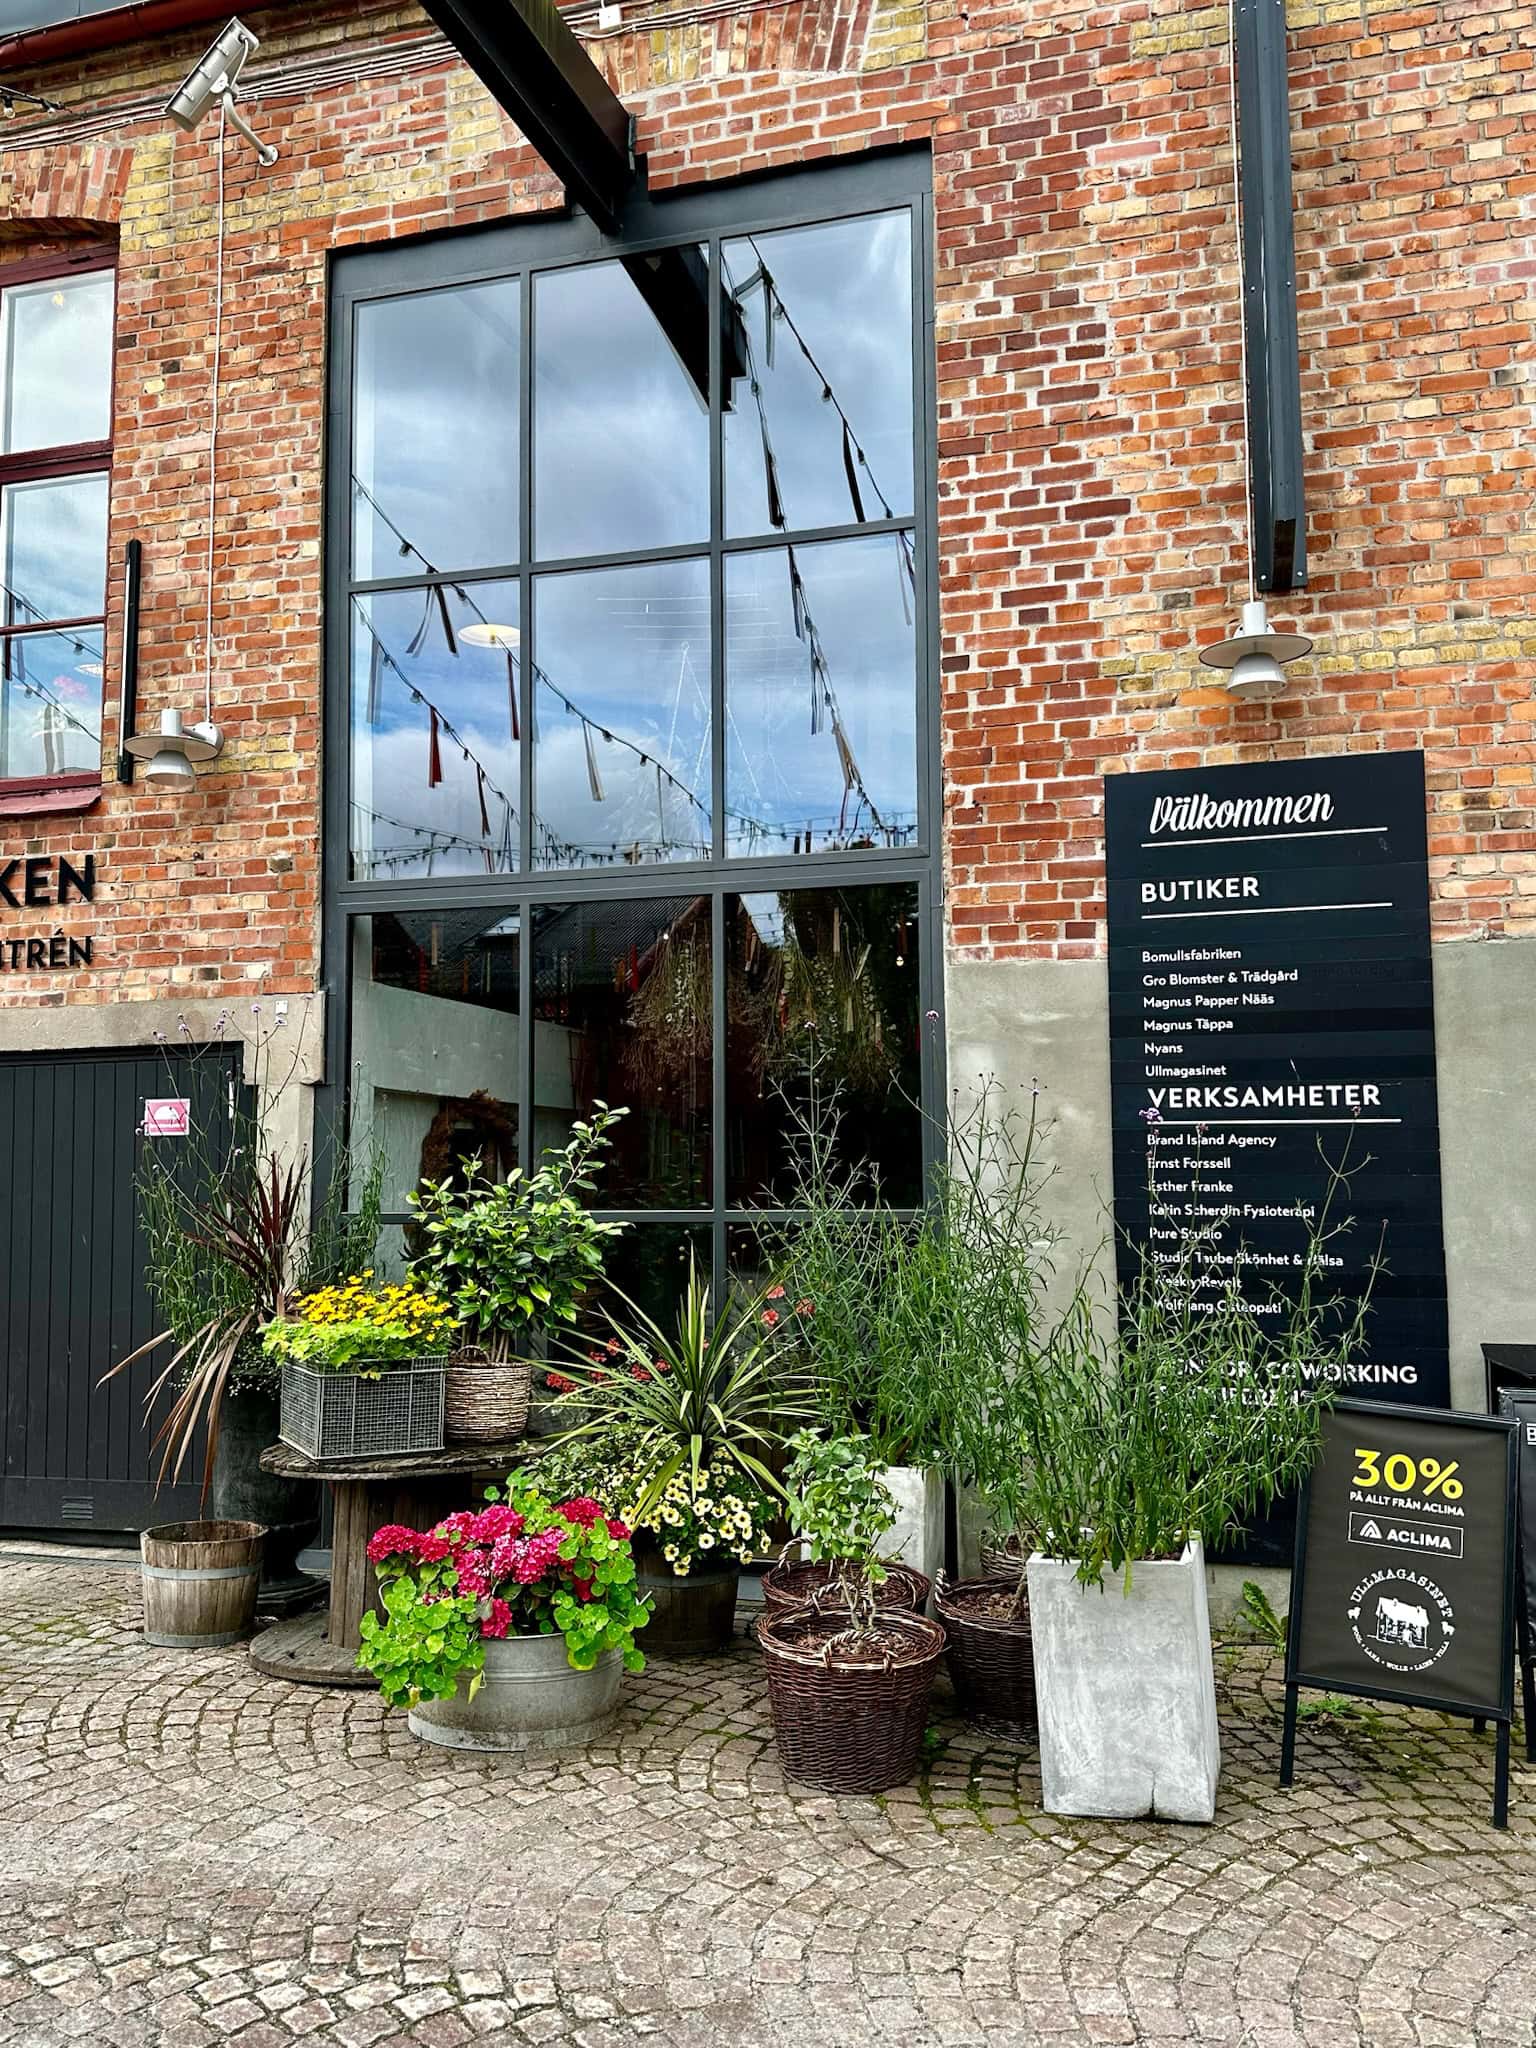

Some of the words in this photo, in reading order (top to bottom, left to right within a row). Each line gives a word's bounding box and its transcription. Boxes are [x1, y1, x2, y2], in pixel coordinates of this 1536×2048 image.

[1149, 792, 1335, 834] Välkommen
[1141, 876, 1260, 903] BUTIKER
[0, 928, 92, 969] TRÉN
[1142, 948, 1242, 963] Bomullsfabriken
[1142, 974, 1167, 986] Gro
[1169, 973, 1225, 986] Blomster
[1227, 972, 1239, 983] &
[1241, 969, 1298, 984] Trädgård
[1143, 996, 1192, 1010] Magnus
[1195, 995, 1240, 1008] Papper
[1242, 993, 1275, 1005] Nääs
[1143, 1019, 1193, 1033] Magnus
[1195, 1018, 1234, 1032] Täppa
[1144, 1042, 1183, 1056] Nyans
[1145, 1065, 1227, 1079] Ullmagasinet
[1147, 1084, 1381, 1109] VERKSAMHETER
[1147, 1133, 1184, 1146] Brand
[1186, 1133, 1225, 1146] Isand
[1228, 1133, 1277, 1148] Agency
[1147, 1157, 1181, 1169] Ernst
[1183, 1156, 1231, 1169] Forssell
[1148, 1180, 1189, 1192] Esther
[1191, 1180, 1234, 1192] Franke
[1184, 1204, 1241, 1216] Scherdin
[1243, 1204, 1315, 1219] Fysioterapi
[1149, 1227, 1178, 1239] Pure
[1236, 1252, 1290, 1265] Skönhet
[1292, 1253, 1303, 1265] &
[1153, 1275, 1197, 1290] eeky
[1154, 1298, 1214, 1314] olfang
[1351, 1448, 1464, 1500] 30%
[1349, 1490, 1363, 1502] PÅ
[1365, 1494, 1391, 1505] ALLT
[1392, 1498, 1421, 1510] FRÅN
[1422, 1502, 1464, 1517] ACLIMA
[1386, 1528, 1452, 1549] ACLIMA
[1350, 1568, 1453, 1617] ULLMAGASINET
